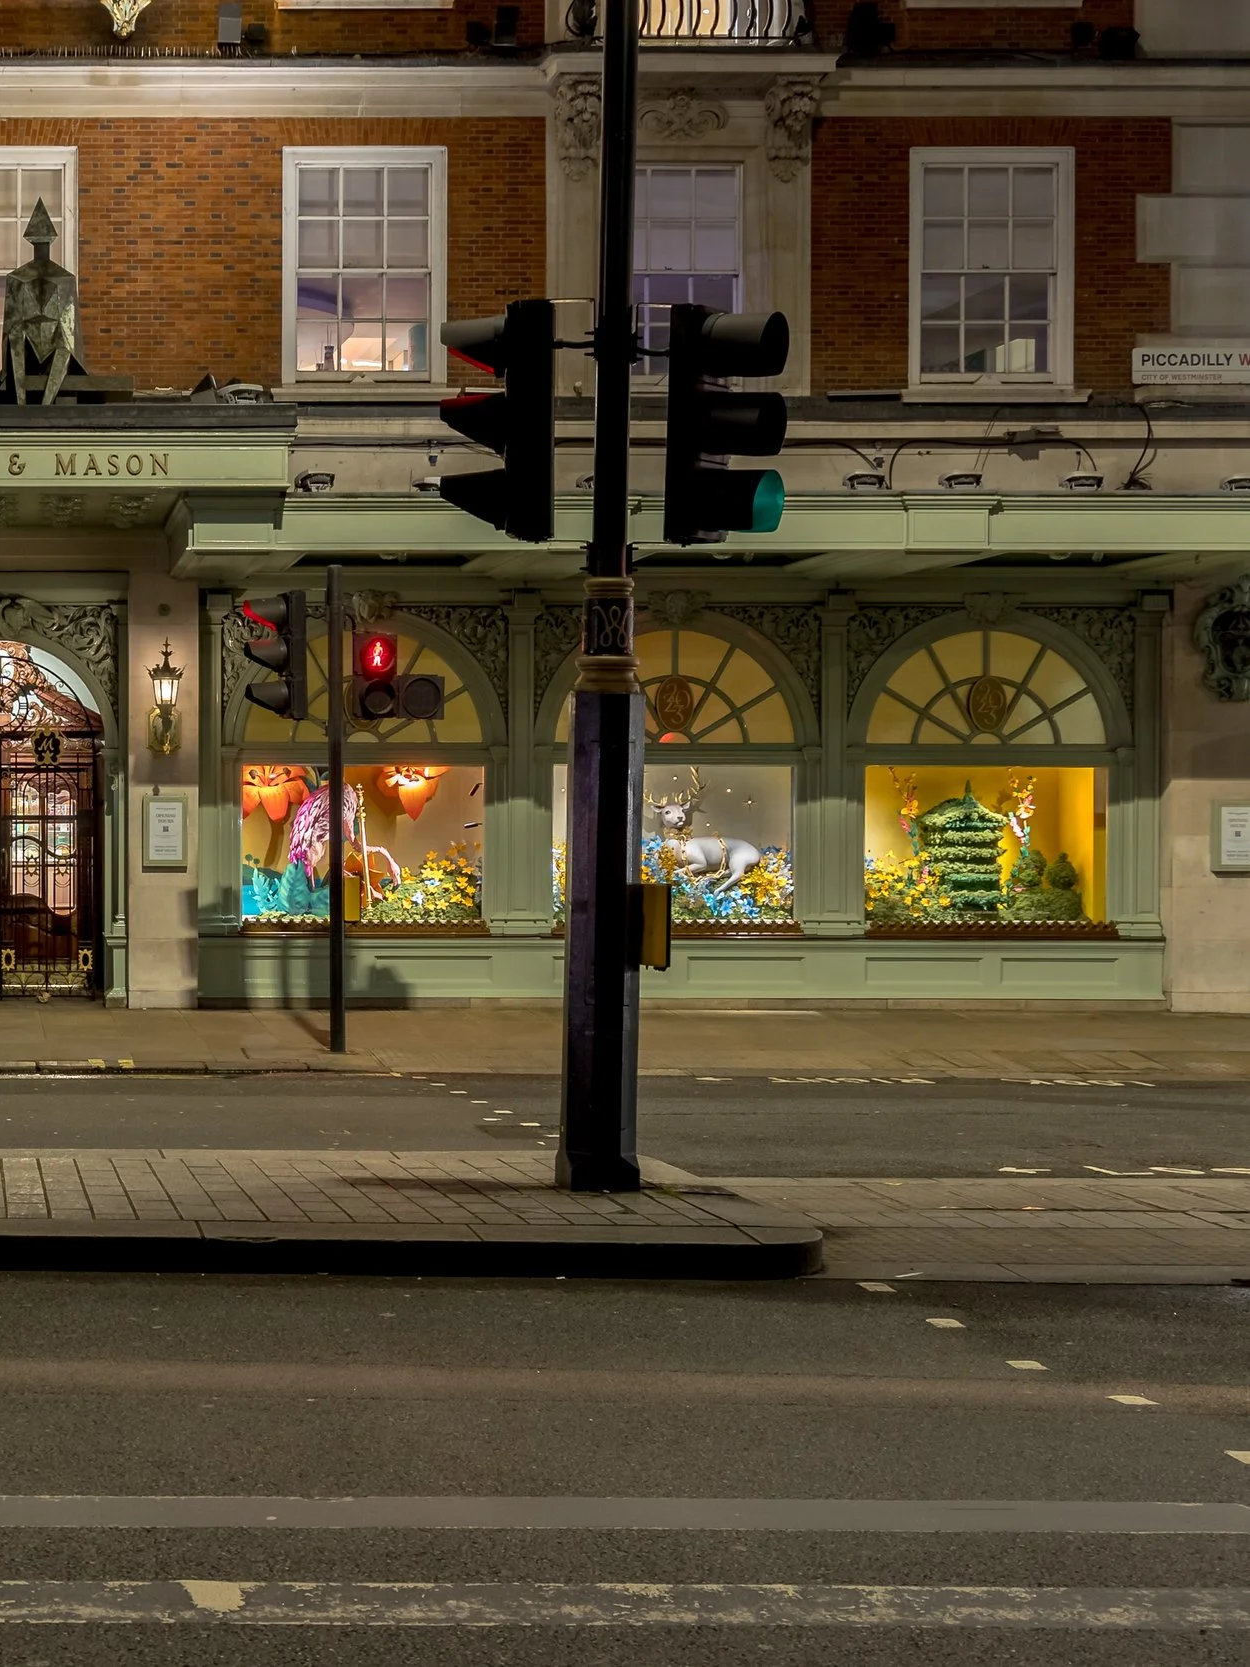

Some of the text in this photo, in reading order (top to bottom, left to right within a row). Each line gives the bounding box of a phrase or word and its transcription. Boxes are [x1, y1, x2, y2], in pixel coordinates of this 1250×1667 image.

[1141, 353, 1233, 366] PICCADILLY
[7, 453, 27, 476] &
[54, 452, 170, 476] MASON
[37, 738, 55, 751] M
